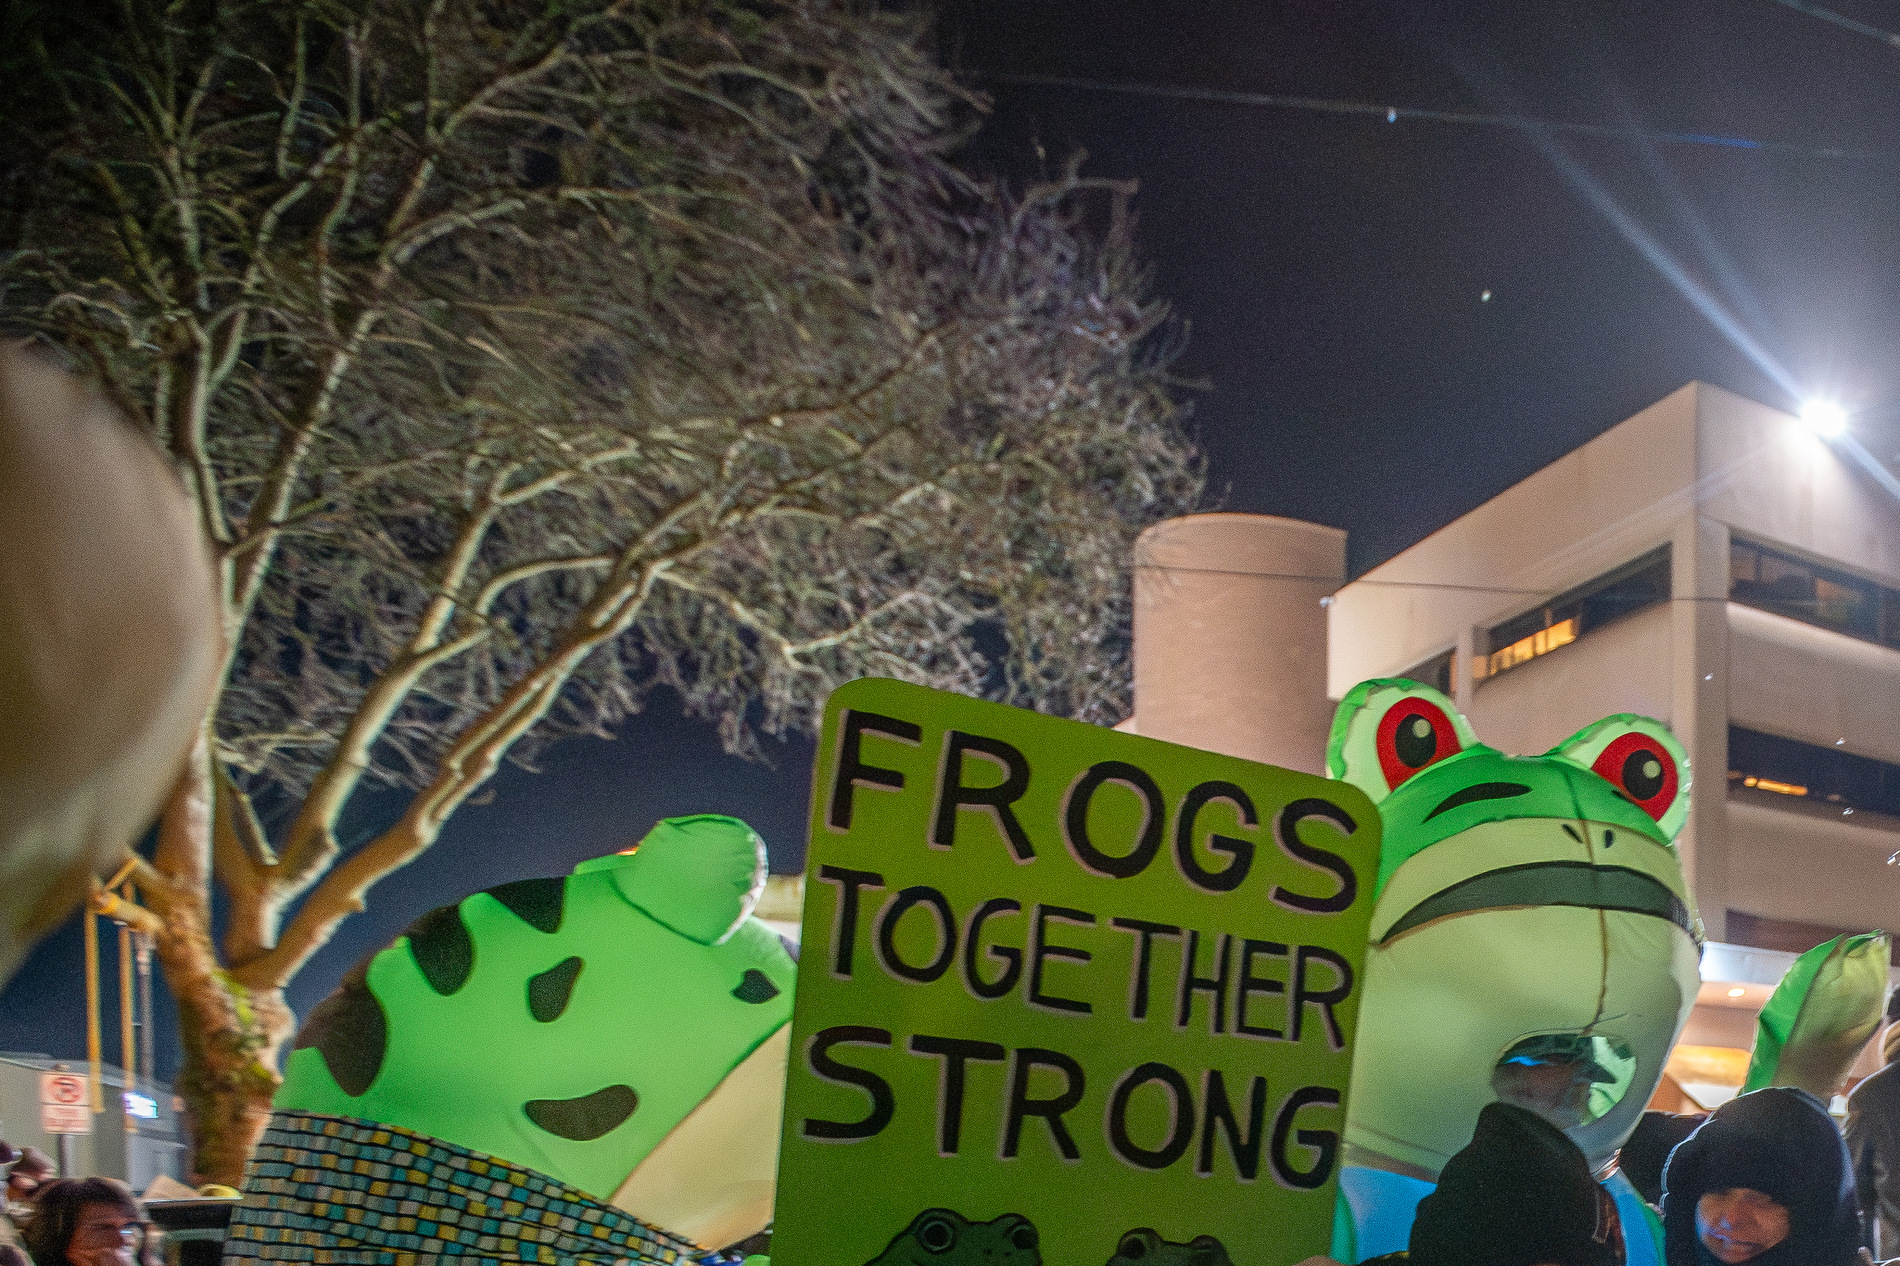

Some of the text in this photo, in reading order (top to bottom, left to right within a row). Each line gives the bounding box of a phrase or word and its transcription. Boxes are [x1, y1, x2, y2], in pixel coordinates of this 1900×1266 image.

[824, 708, 1359, 913] FROGS
[816, 864, 1354, 1051] TOGETHER
[801, 1025, 1341, 1190] STRONG
